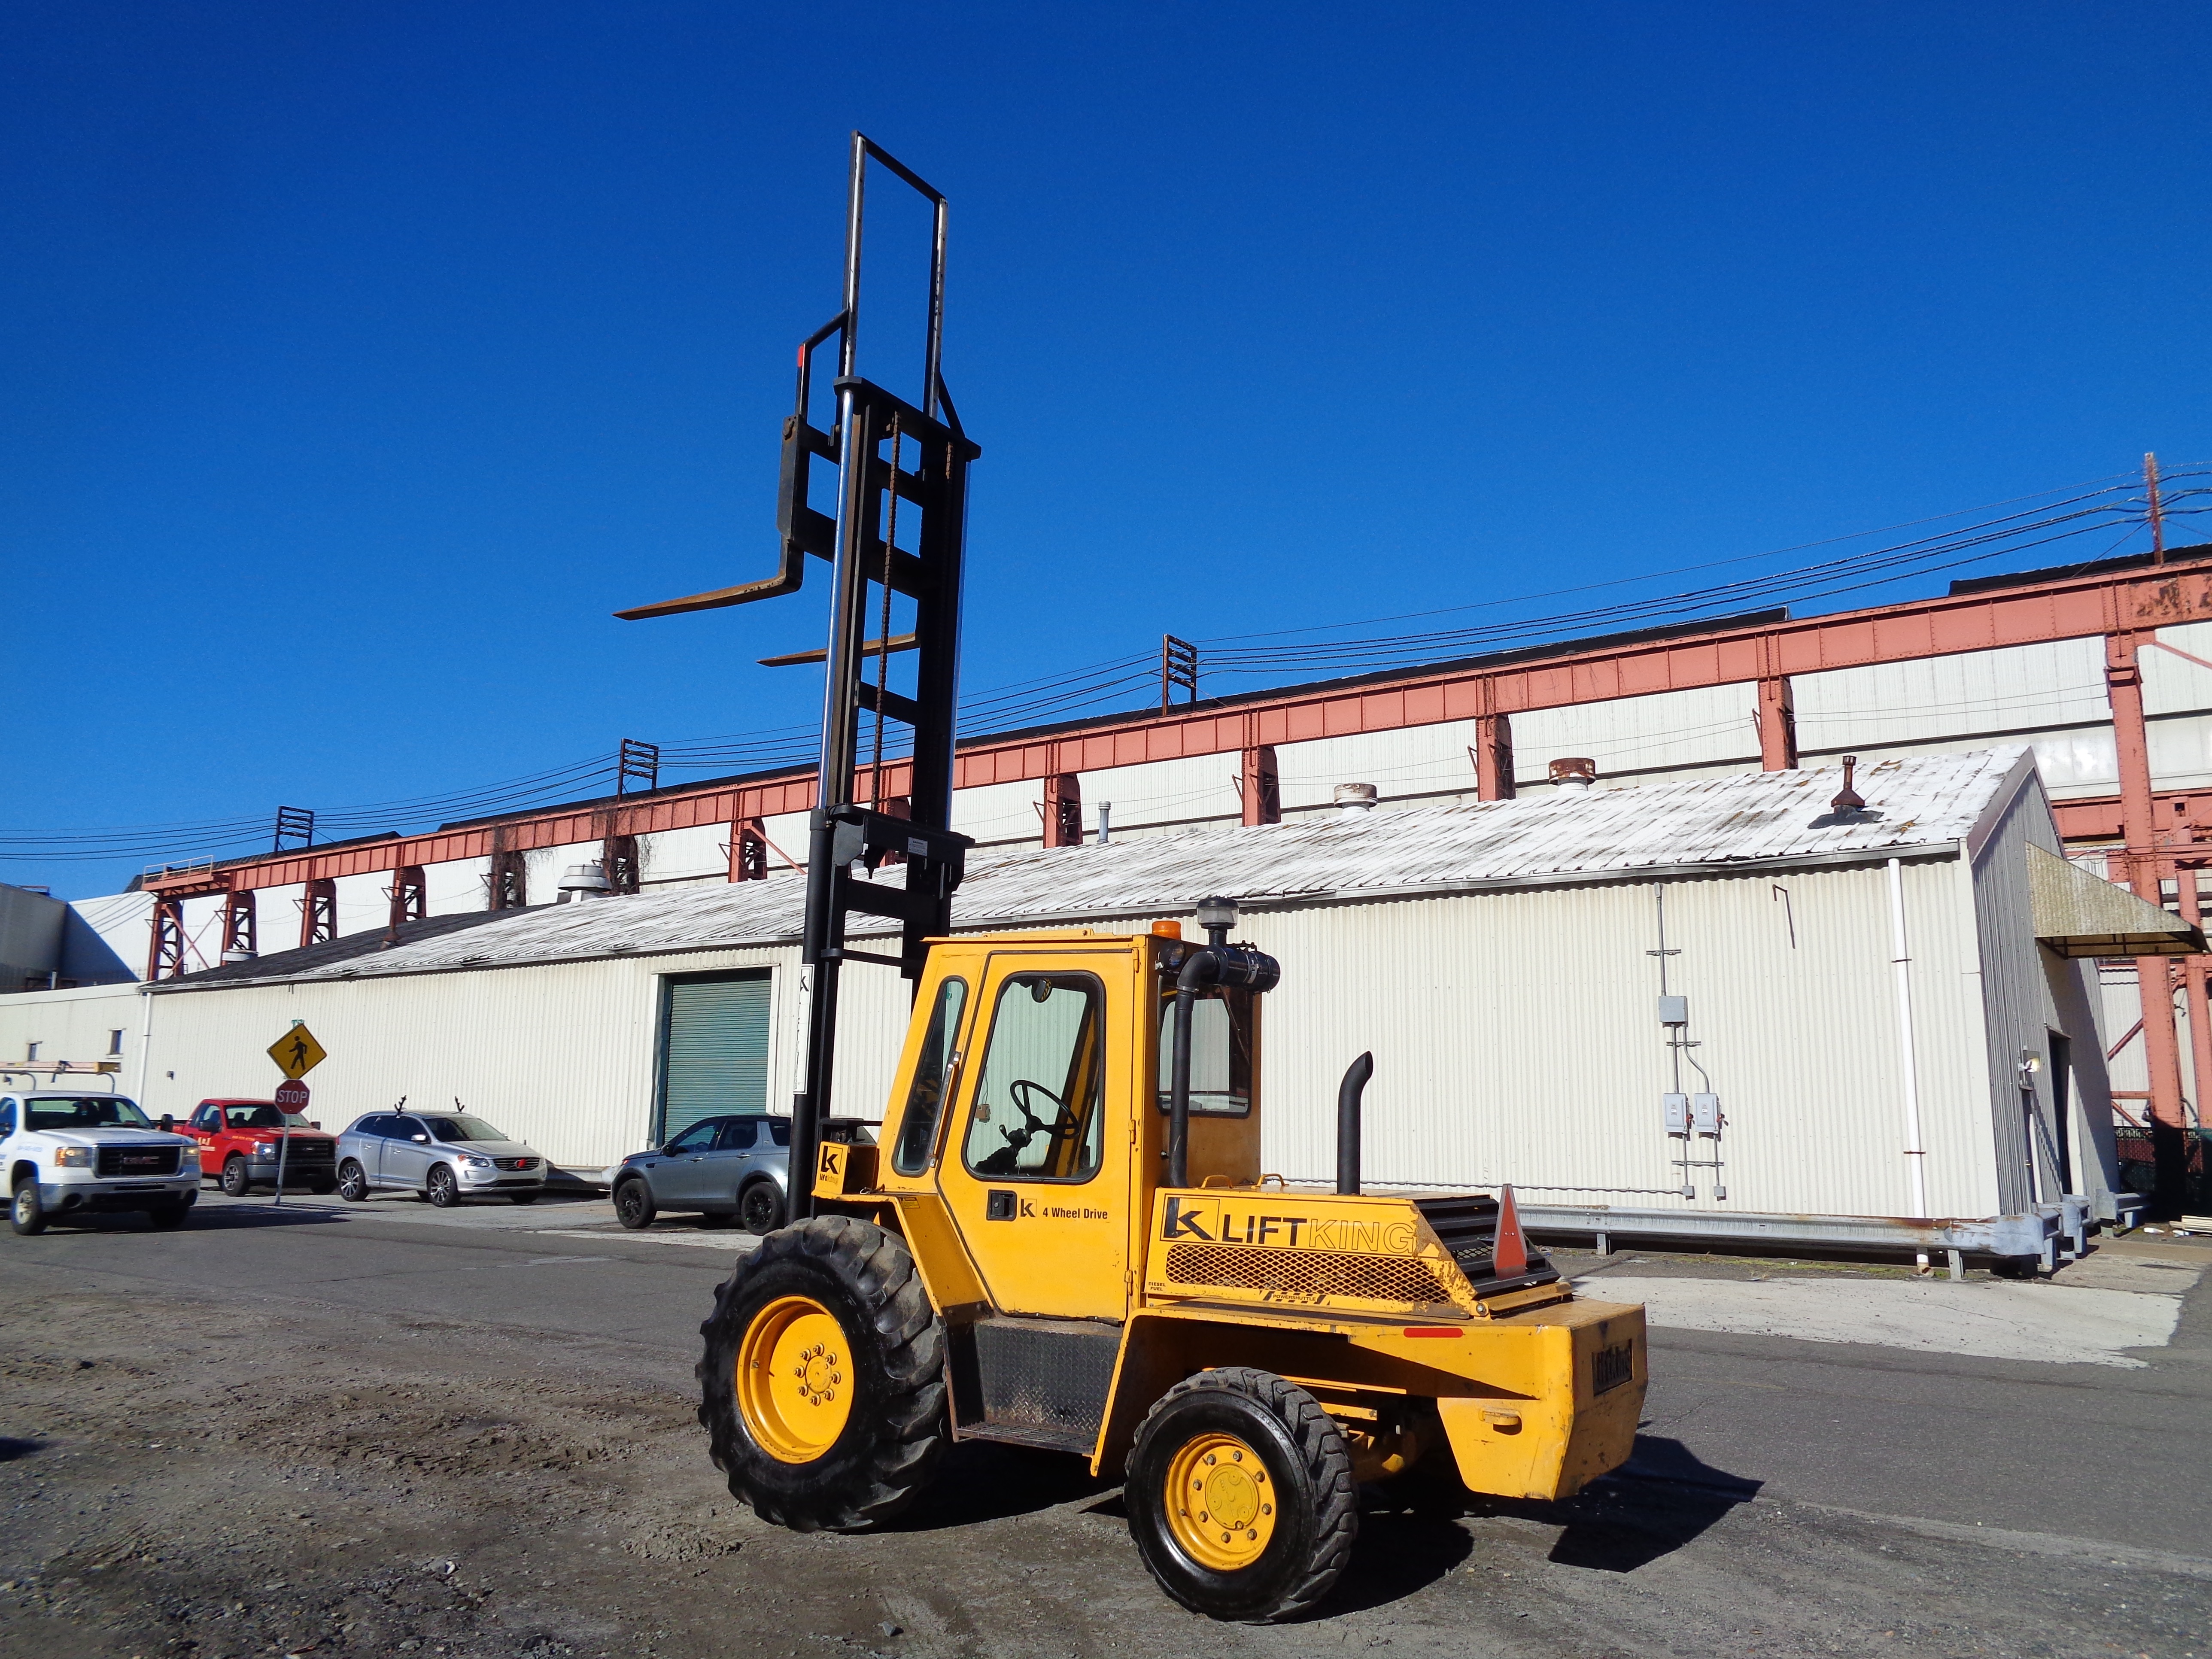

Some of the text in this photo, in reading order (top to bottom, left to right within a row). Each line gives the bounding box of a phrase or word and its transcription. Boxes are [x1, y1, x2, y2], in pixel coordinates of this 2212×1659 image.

[276, 1089, 308, 1103] STOP
[1042, 1207, 1048, 1217] 4
[1051, 1207, 1080, 1218] Wheel
[1084, 1208, 1108, 1219] Drive
